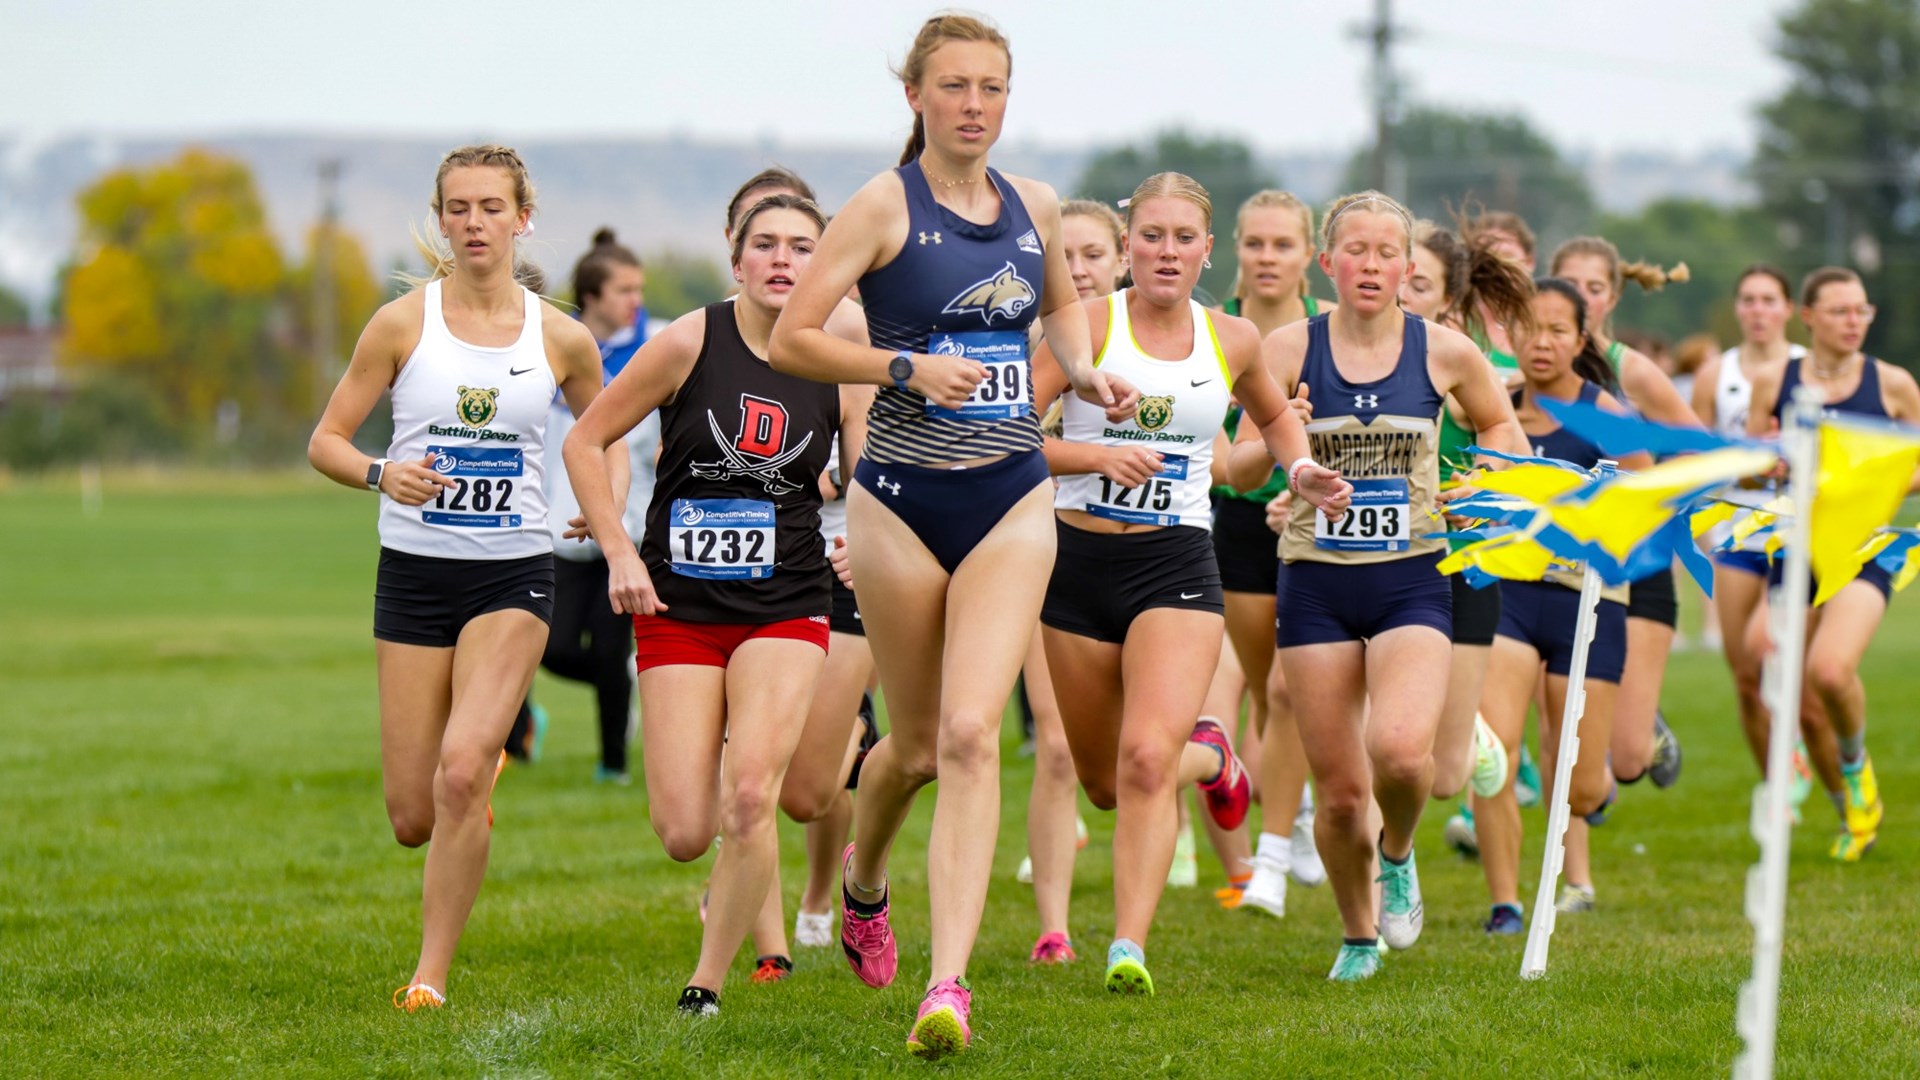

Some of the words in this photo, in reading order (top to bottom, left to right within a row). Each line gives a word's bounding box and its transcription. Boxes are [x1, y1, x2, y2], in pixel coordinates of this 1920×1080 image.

[966, 364, 1020, 402] 39
[734, 393, 789, 460] D
[434, 478, 513, 512] 1282
[1099, 476, 1172, 511] 1275
[1326, 507, 1399, 537] 1293
[679, 530, 765, 564] 1232
